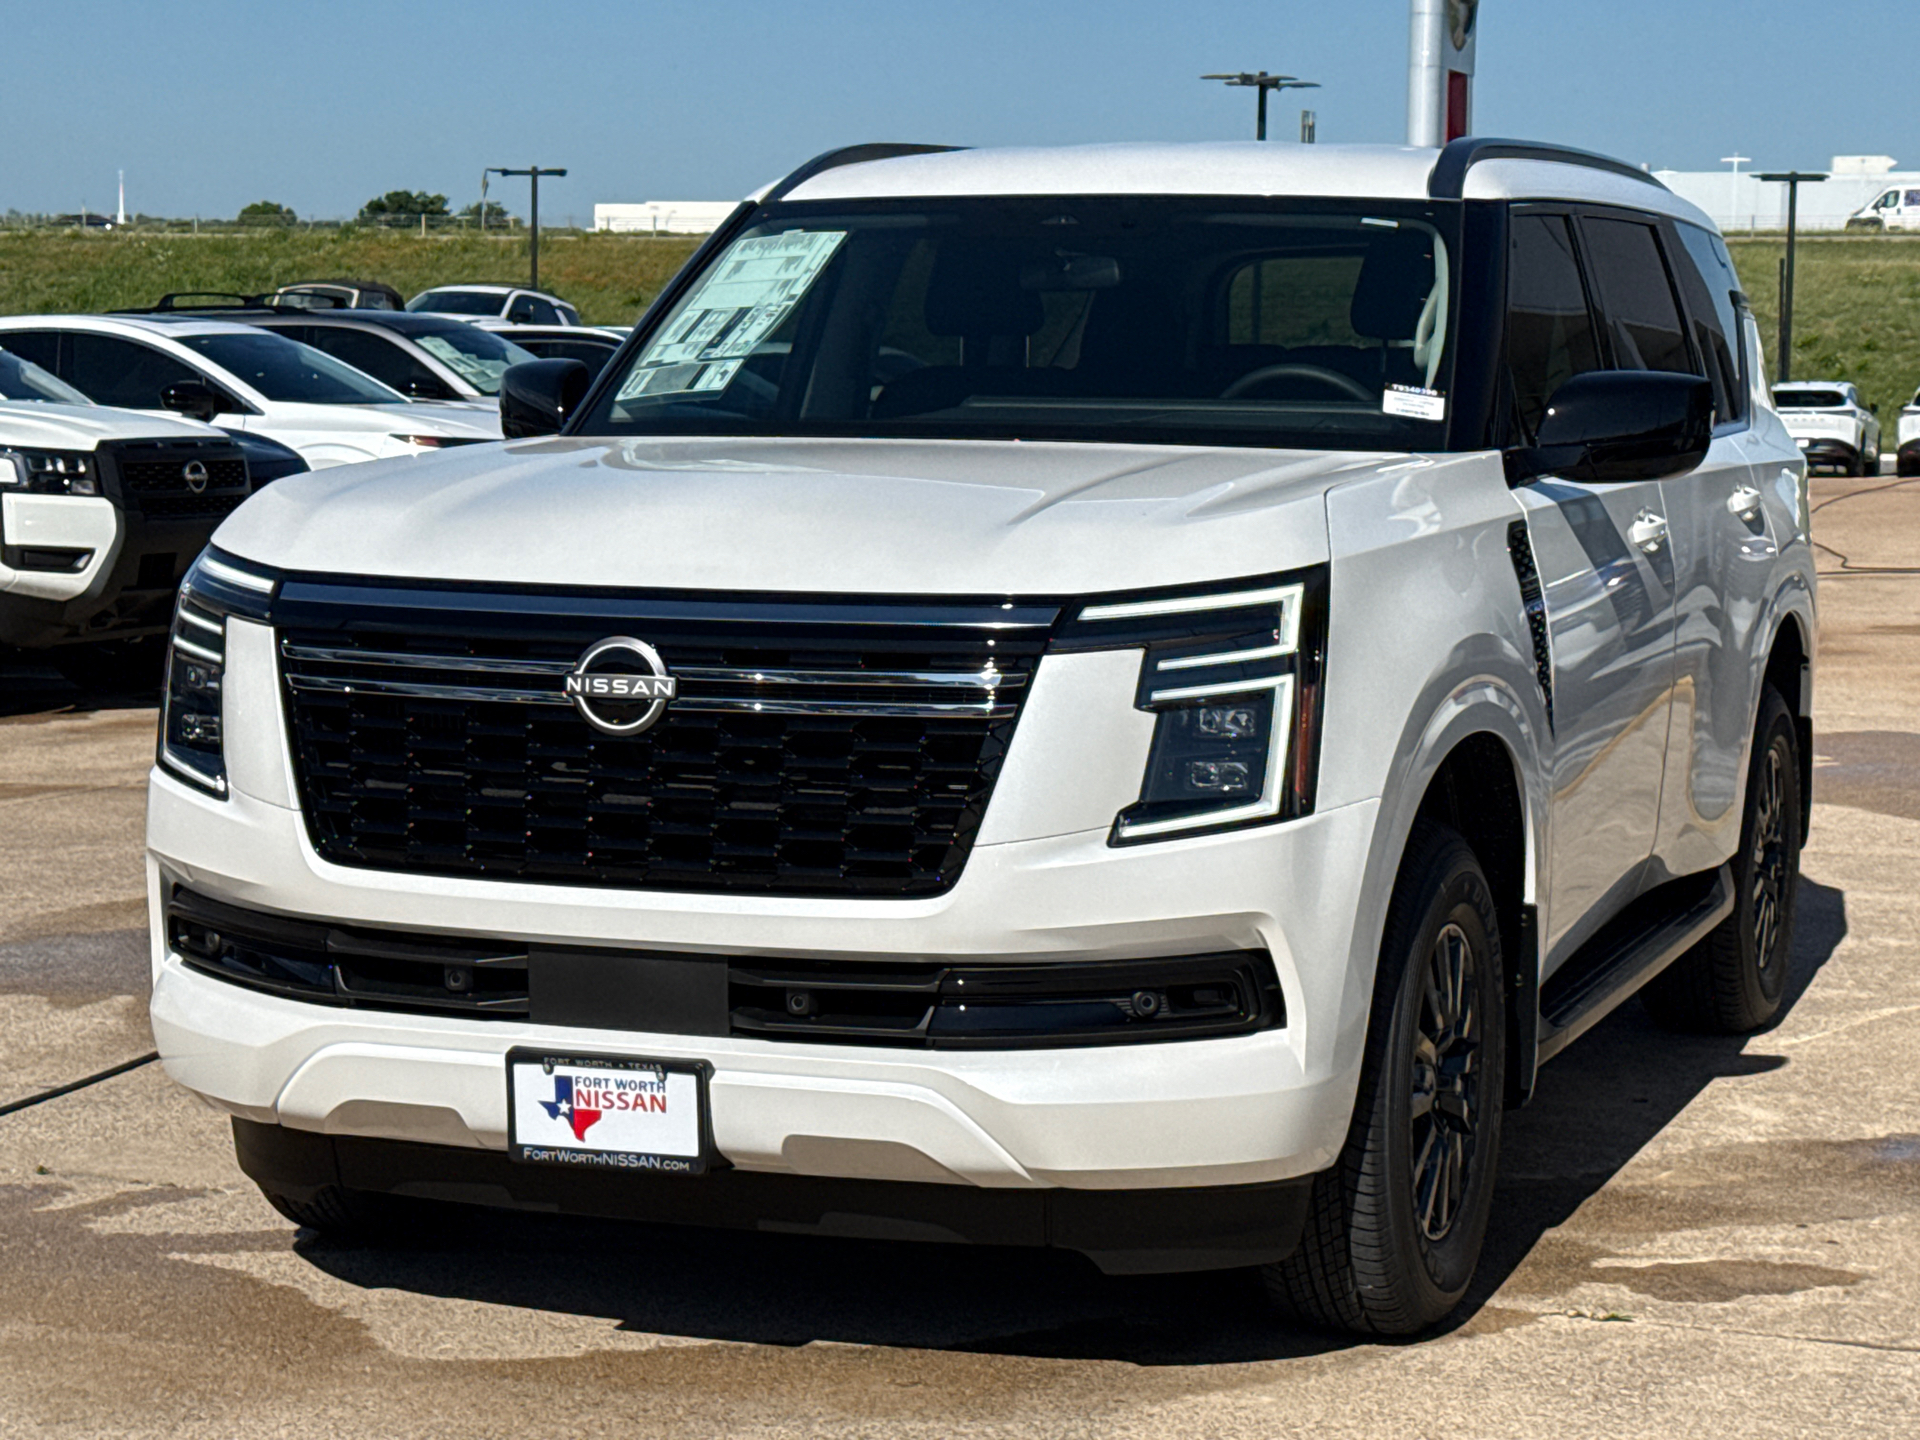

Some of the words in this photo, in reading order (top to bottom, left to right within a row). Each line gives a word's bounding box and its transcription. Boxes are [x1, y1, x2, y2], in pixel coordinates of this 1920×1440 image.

[566, 677, 672, 696] NISSAN
[543, 1057, 570, 1066] FORT
[575, 1059, 613, 1068] WORTH
[628, 1062, 663, 1071] TEXAS
[575, 1077, 611, 1089] FORT
[615, 1078, 666, 1093] WORTH
[575, 1089, 667, 1113] NISSAN
